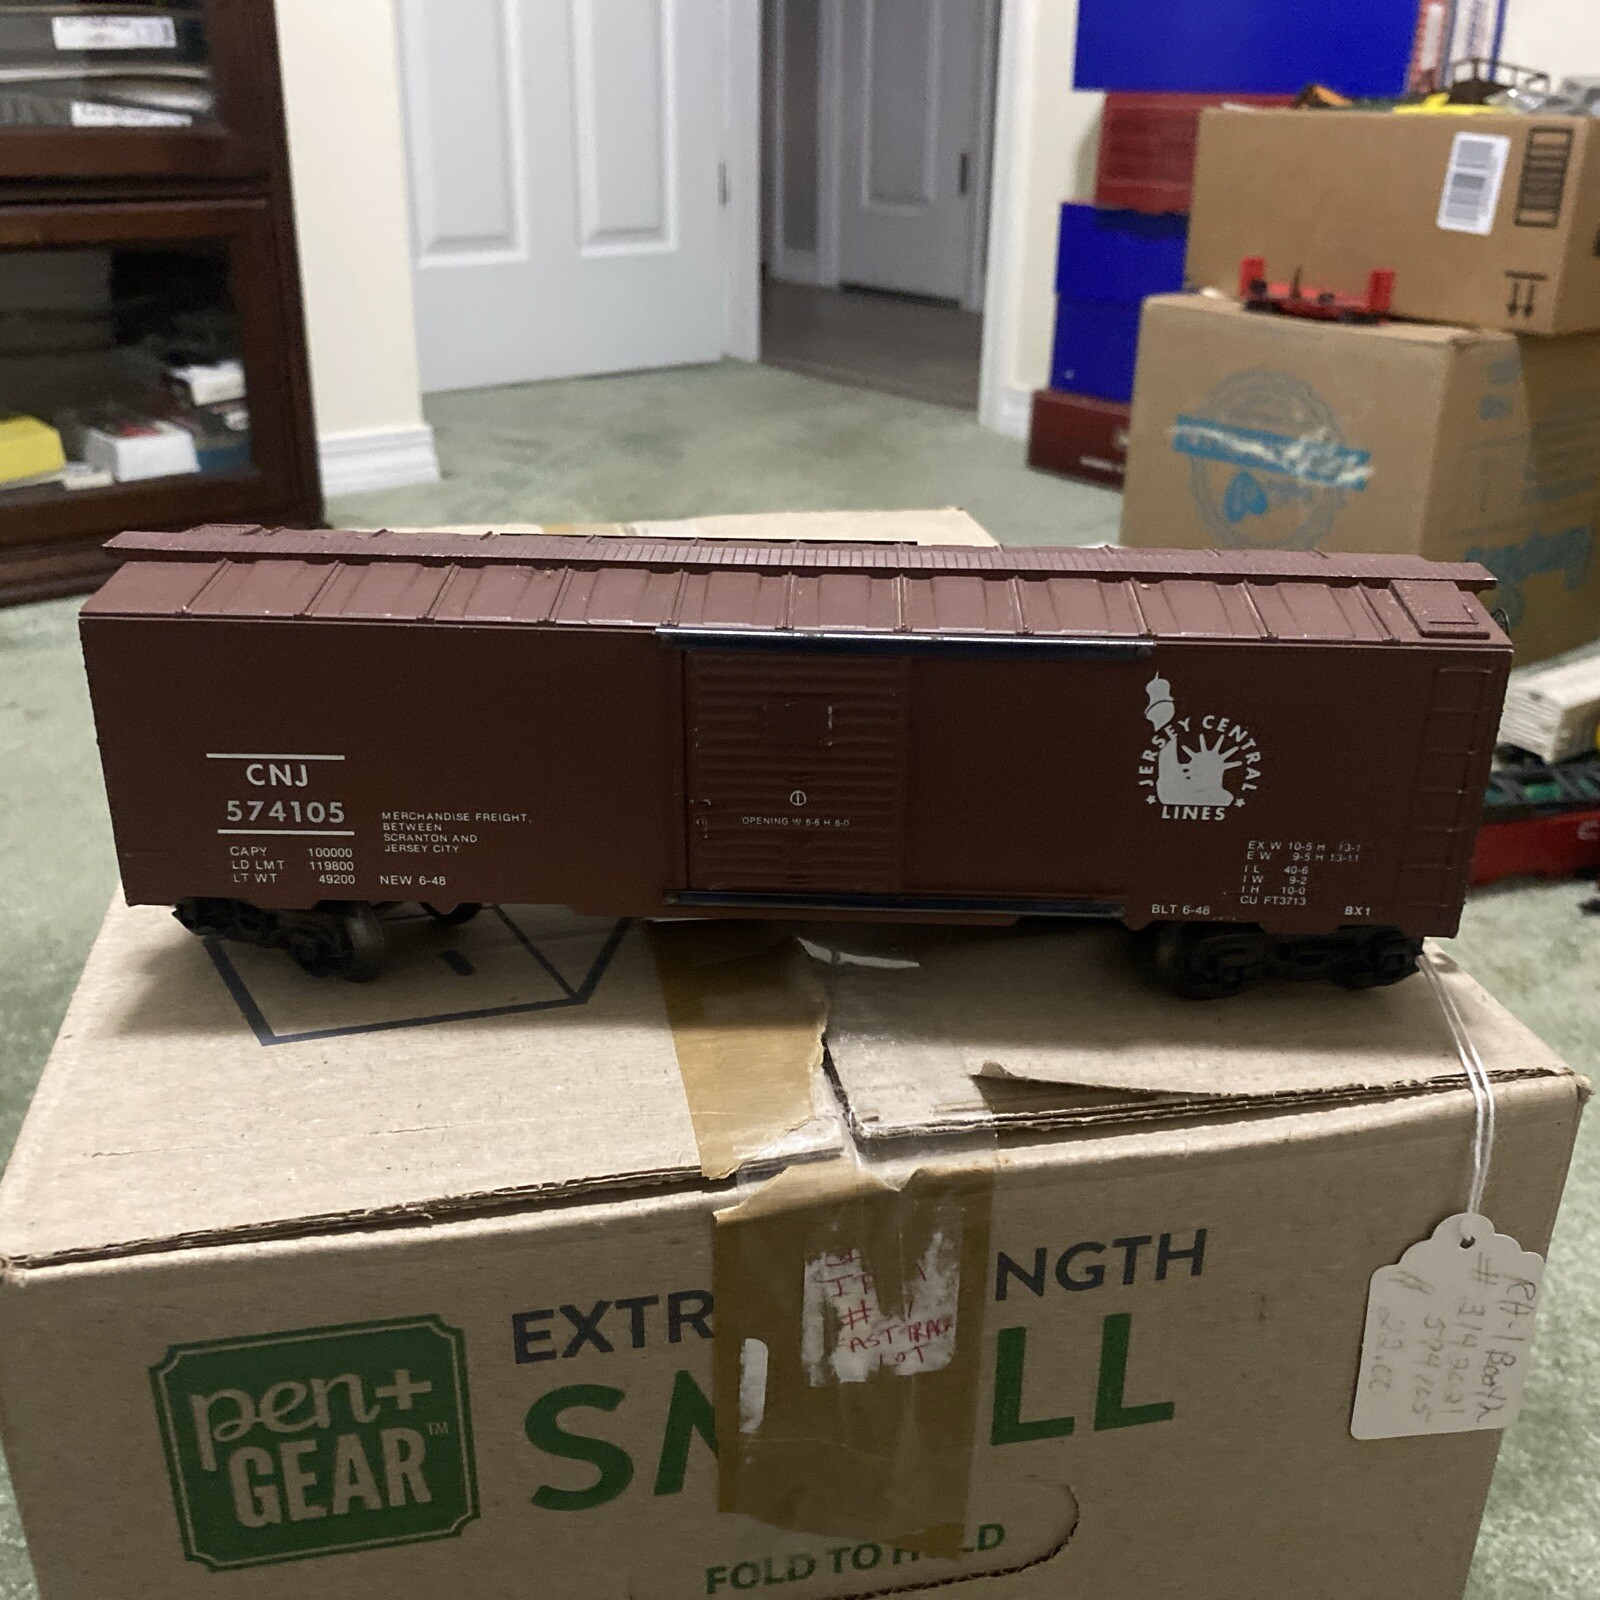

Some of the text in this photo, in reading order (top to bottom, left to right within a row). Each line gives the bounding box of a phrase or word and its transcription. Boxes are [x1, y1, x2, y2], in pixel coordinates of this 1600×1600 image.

[1139, 715, 1261, 791] JERSEY CENTRAL
[247, 764, 307, 786] CNJ
[227, 801, 344, 823] 574105
[382, 812, 469, 821] MERCHANDISE
[1161, 806, 1226, 821] LINES
[383, 823, 441, 831] BETWEEN
[743, 817, 788, 825] OPENING
[792, 817, 802, 826] W
[384, 833, 477, 843] SCRANTON AND
[385, 844, 427, 852] JERSEY
[1248, 841, 1264, 850] EX
[1270, 842, 1282, 851] W
[230, 846, 352, 858] CAPY 100000
[1247, 851, 1253, 860] E
[1260, 852, 1271, 860] W
[1315, 854, 1323, 863] H
[232, 860, 354, 871] LD LMT 119800
[1253, 865, 1260, 873] L
[1284, 866, 1309, 875] 40-6
[234, 873, 355, 884] LT WT 49200
[380, 875, 446, 885] NEW 6-48
[1252, 876, 1264, 884] W
[1289, 877, 1307, 885] 9-2
[1240, 896, 1258, 905] CU
[1152, 904, 1210, 915] BLT 6-48
[1345, 906, 1370, 915] BX1
[512, 1228, 1207, 1364] EXTR NGTH
[228, 1427, 432, 1527] GEAR
[706, 1554, 816, 1594] FOLD
[829, 1543, 882, 1574] TO
